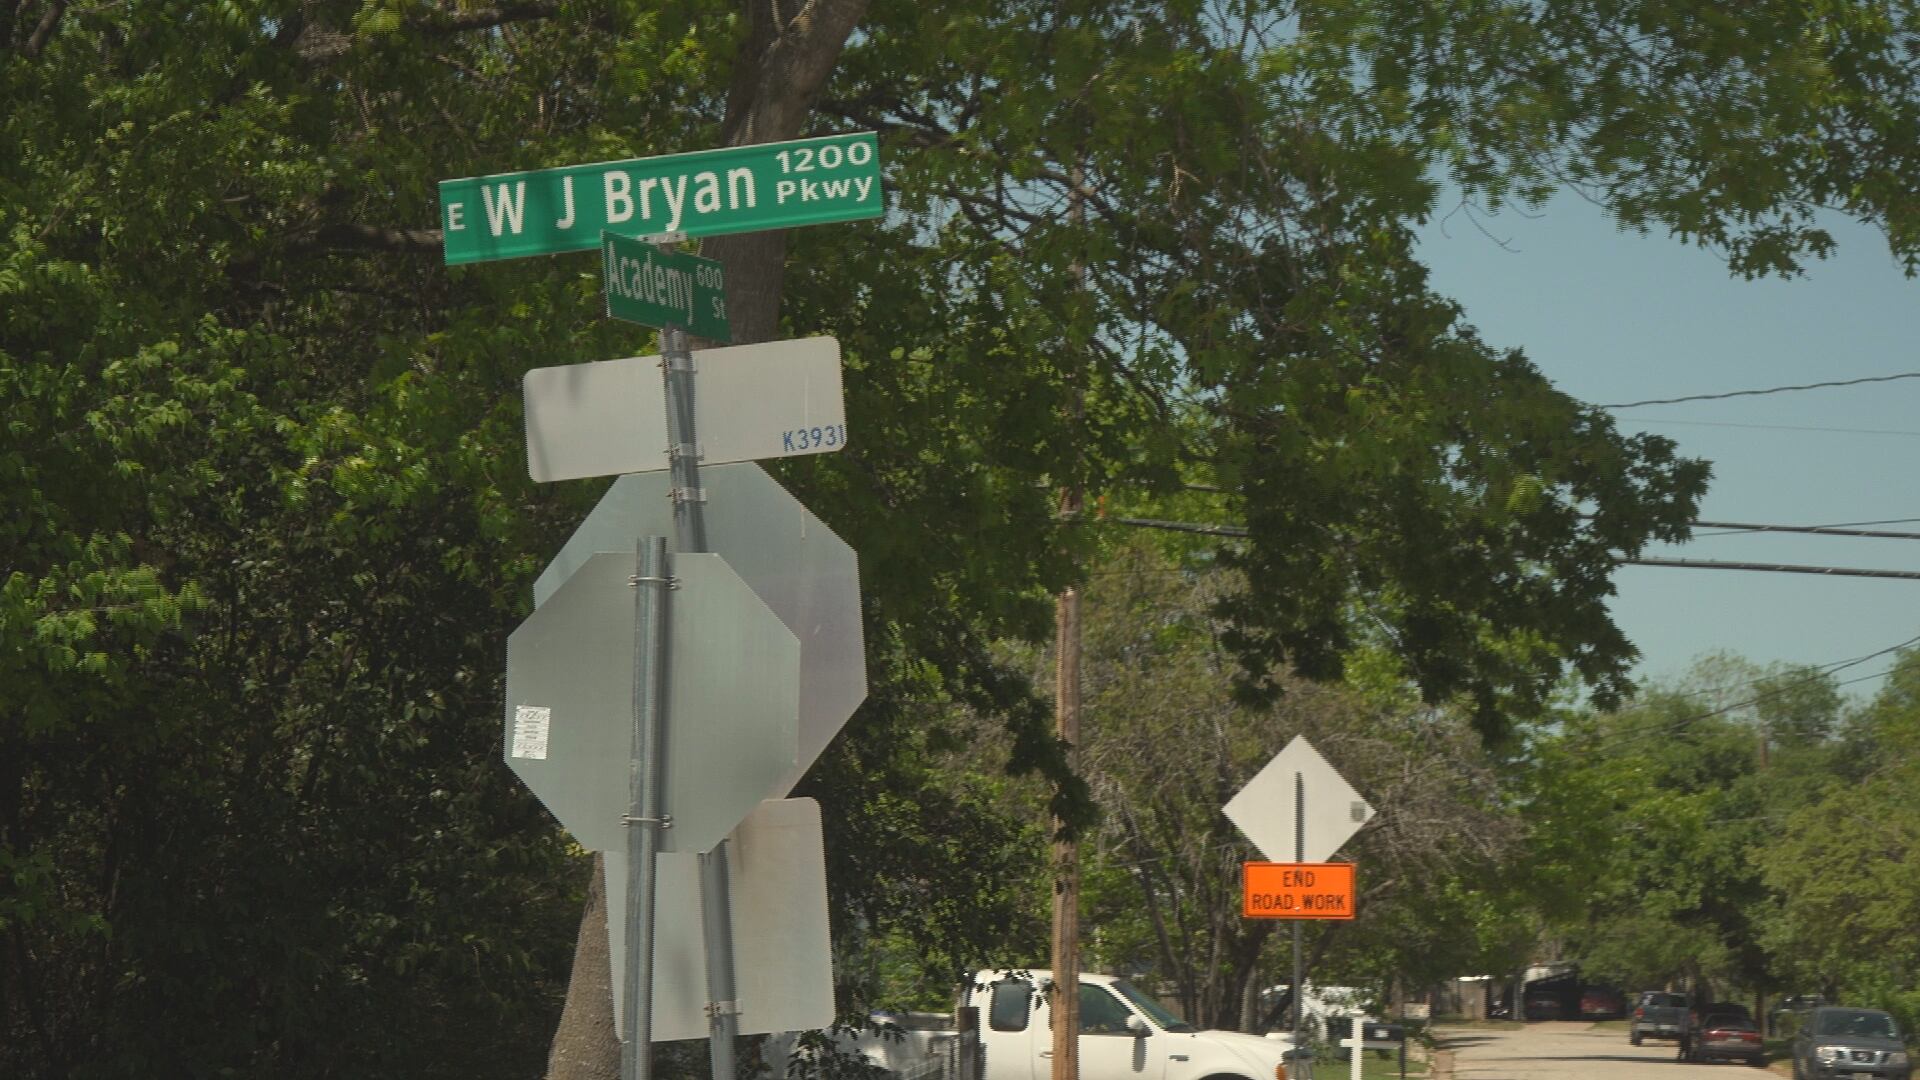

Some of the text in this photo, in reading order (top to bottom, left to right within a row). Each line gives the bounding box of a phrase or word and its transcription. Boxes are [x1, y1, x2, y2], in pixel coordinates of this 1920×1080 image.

[775, 142, 872, 173] 1200
[448, 166, 756, 236] E W J Bryan
[776, 176, 873, 204] Pkwy
[607, 240, 724, 326] Academy 600
[711, 296, 727, 320] St
[782, 424, 845, 452] K3931
[1282, 870, 1316, 888] END
[1252, 894, 1346, 910] ROAD WORK
